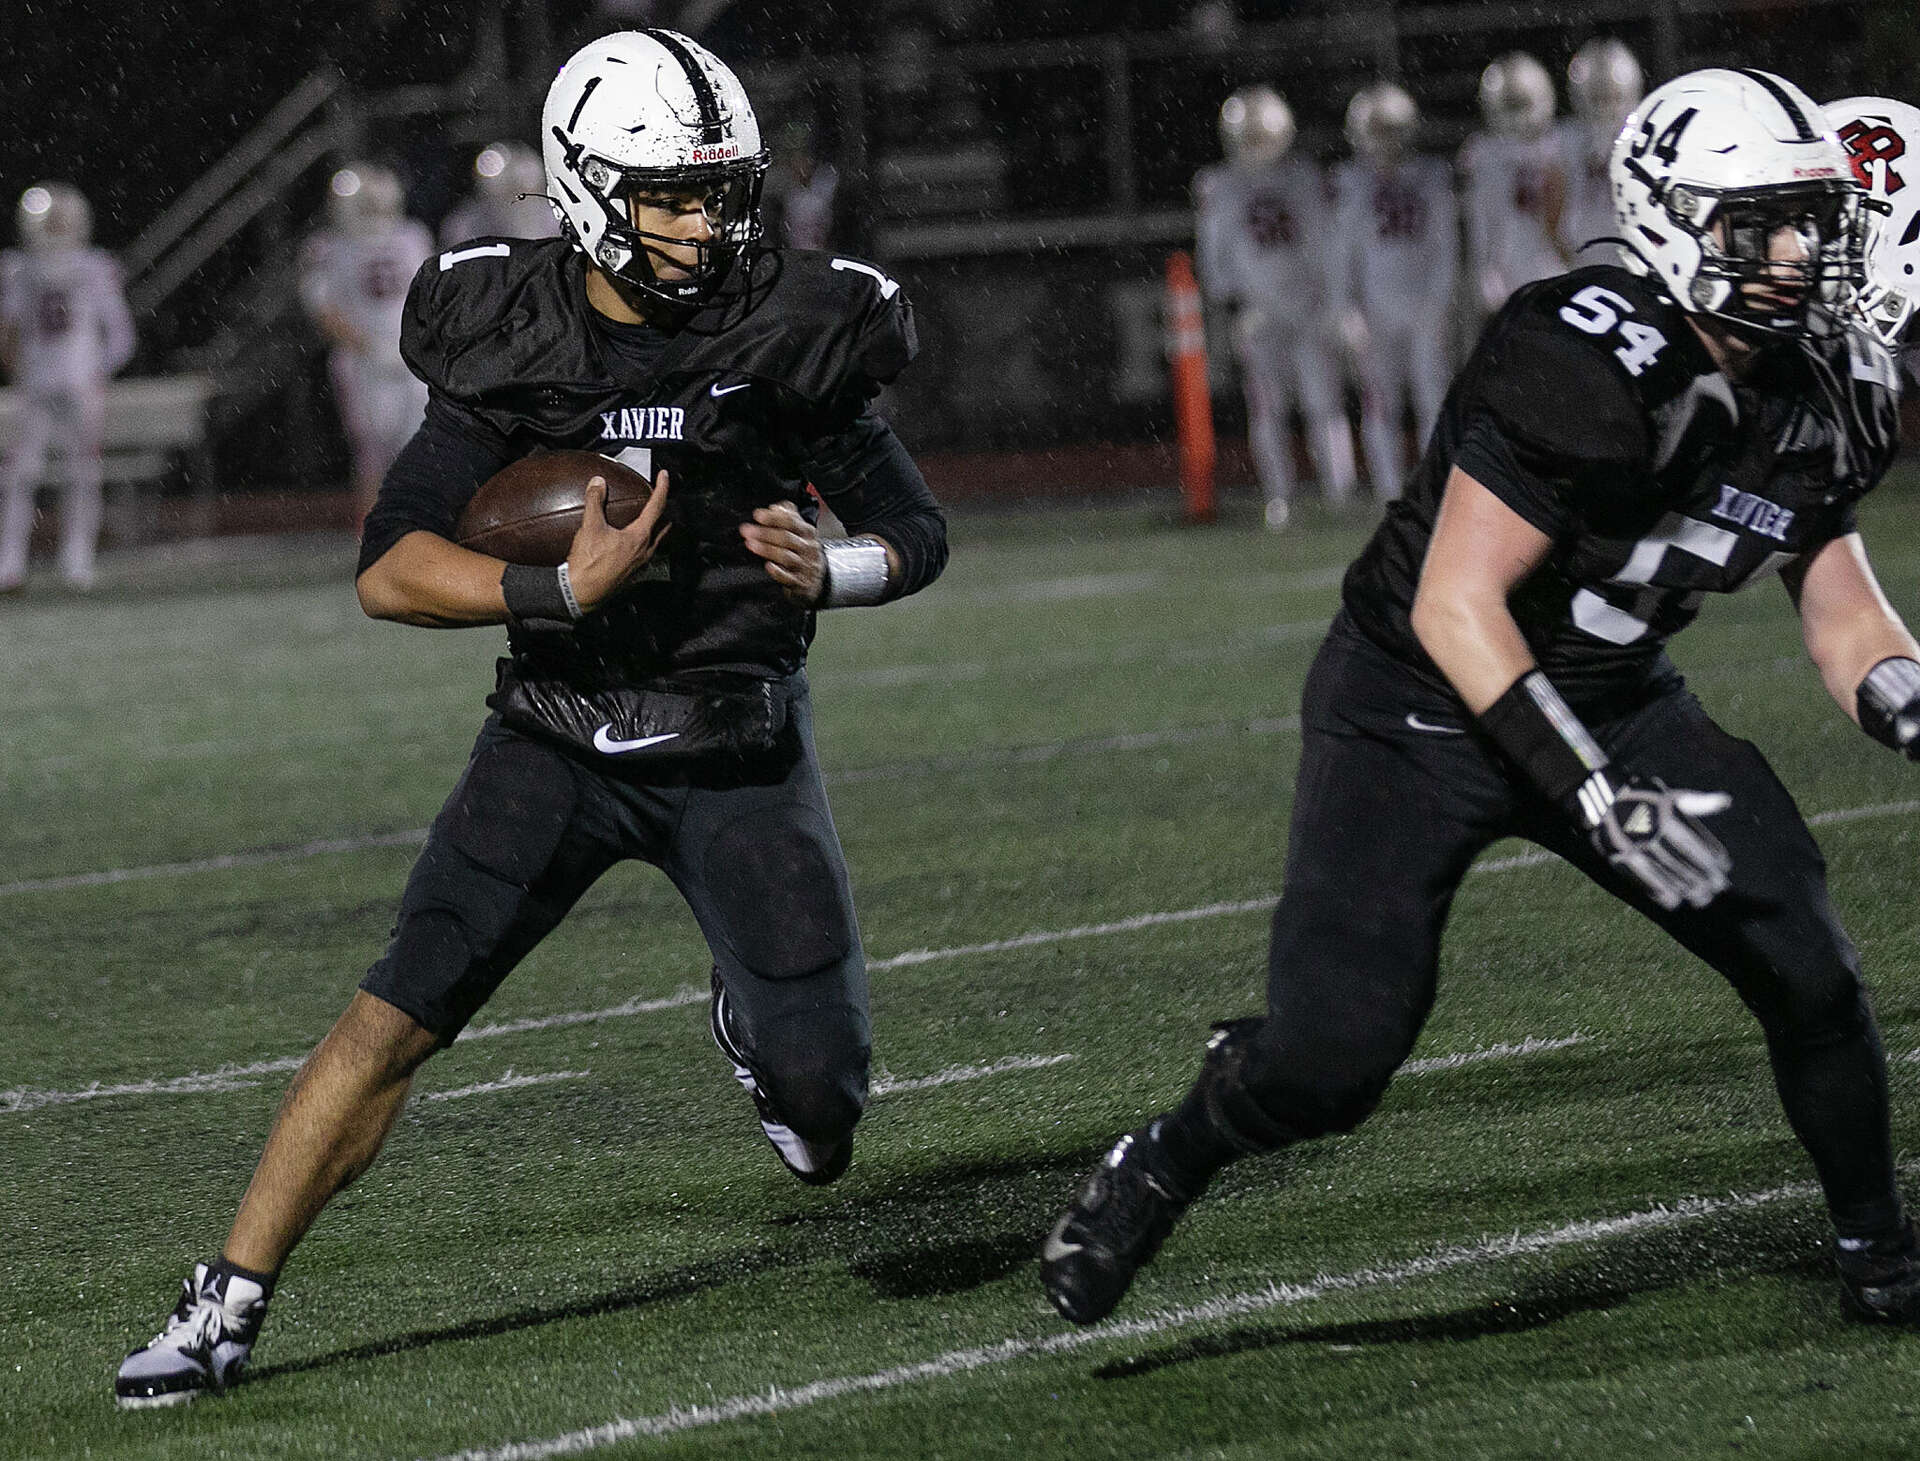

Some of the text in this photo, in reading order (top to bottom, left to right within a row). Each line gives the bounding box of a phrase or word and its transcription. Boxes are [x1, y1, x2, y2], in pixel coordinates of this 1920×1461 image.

[692, 144, 738, 161] Riddell
[439, 243, 510, 272] 1
[830, 258, 901, 300] 1
[1559, 285, 1668, 377] 54
[599, 406, 685, 441] XAVIER
